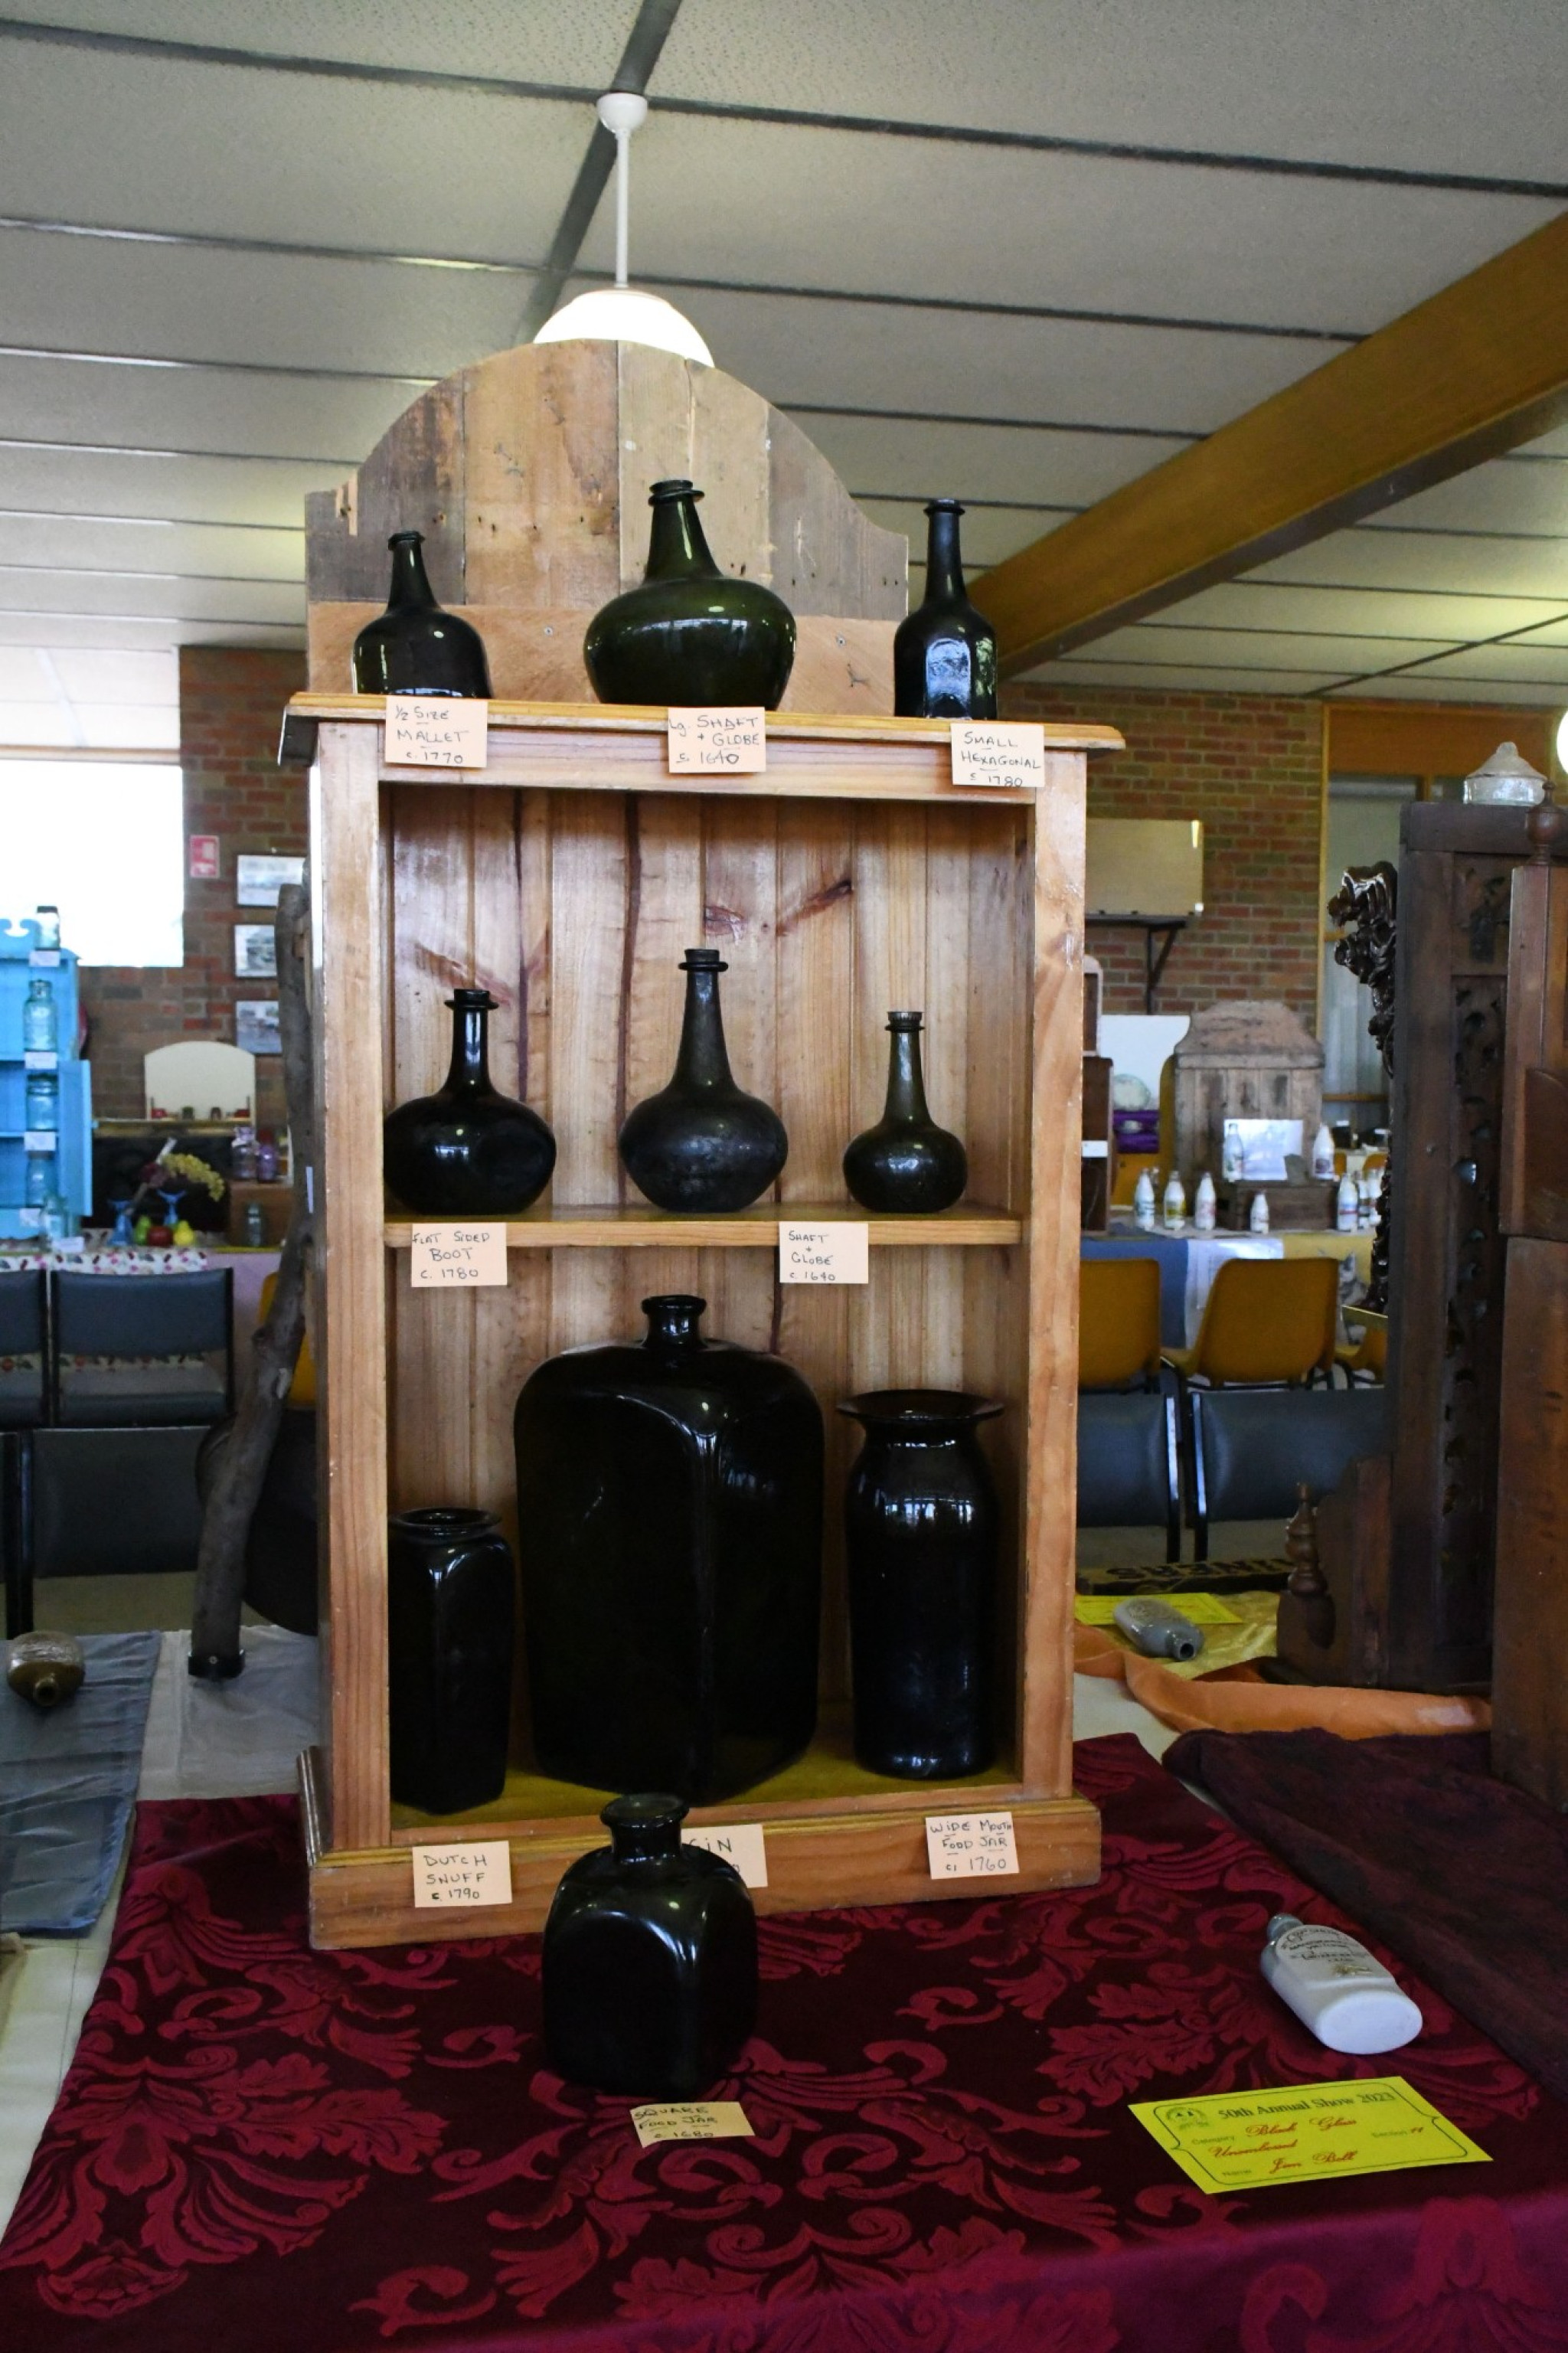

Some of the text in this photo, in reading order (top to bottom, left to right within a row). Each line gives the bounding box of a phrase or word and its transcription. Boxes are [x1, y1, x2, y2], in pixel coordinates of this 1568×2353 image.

[397, 729, 469, 743] MALLET
[713, 732, 760, 746] GLOBE
[964, 731, 1018, 747] SMALL
[425, 751, 463, 764] 1770
[701, 750, 740, 764] 1640
[960, 750, 1041, 769] HEXAGONAL
[988, 776, 1023, 788] 1780
[789, 1230, 828, 1243] SHAFT
[429, 1247, 473, 1262] BOOT
[791, 1252, 834, 1265] GLOBE
[442, 1267, 479, 1279] 1780
[805, 1271, 836, 1282] 1640
[942, 1835, 1008, 1849] FOOD JAR
[423, 1854, 487, 1867] DUTCH
[970, 1856, 1006, 1871] 1760
[426, 1872, 485, 1884] SNUFF
[449, 1887, 480, 1900] 1790
[1217, 2107, 1253, 2119] 50th
[1256, 2100, 1310, 2115] Annual
[1311, 2096, 1354, 2109] Show
[1357, 2092, 1396, 2103] 2023
